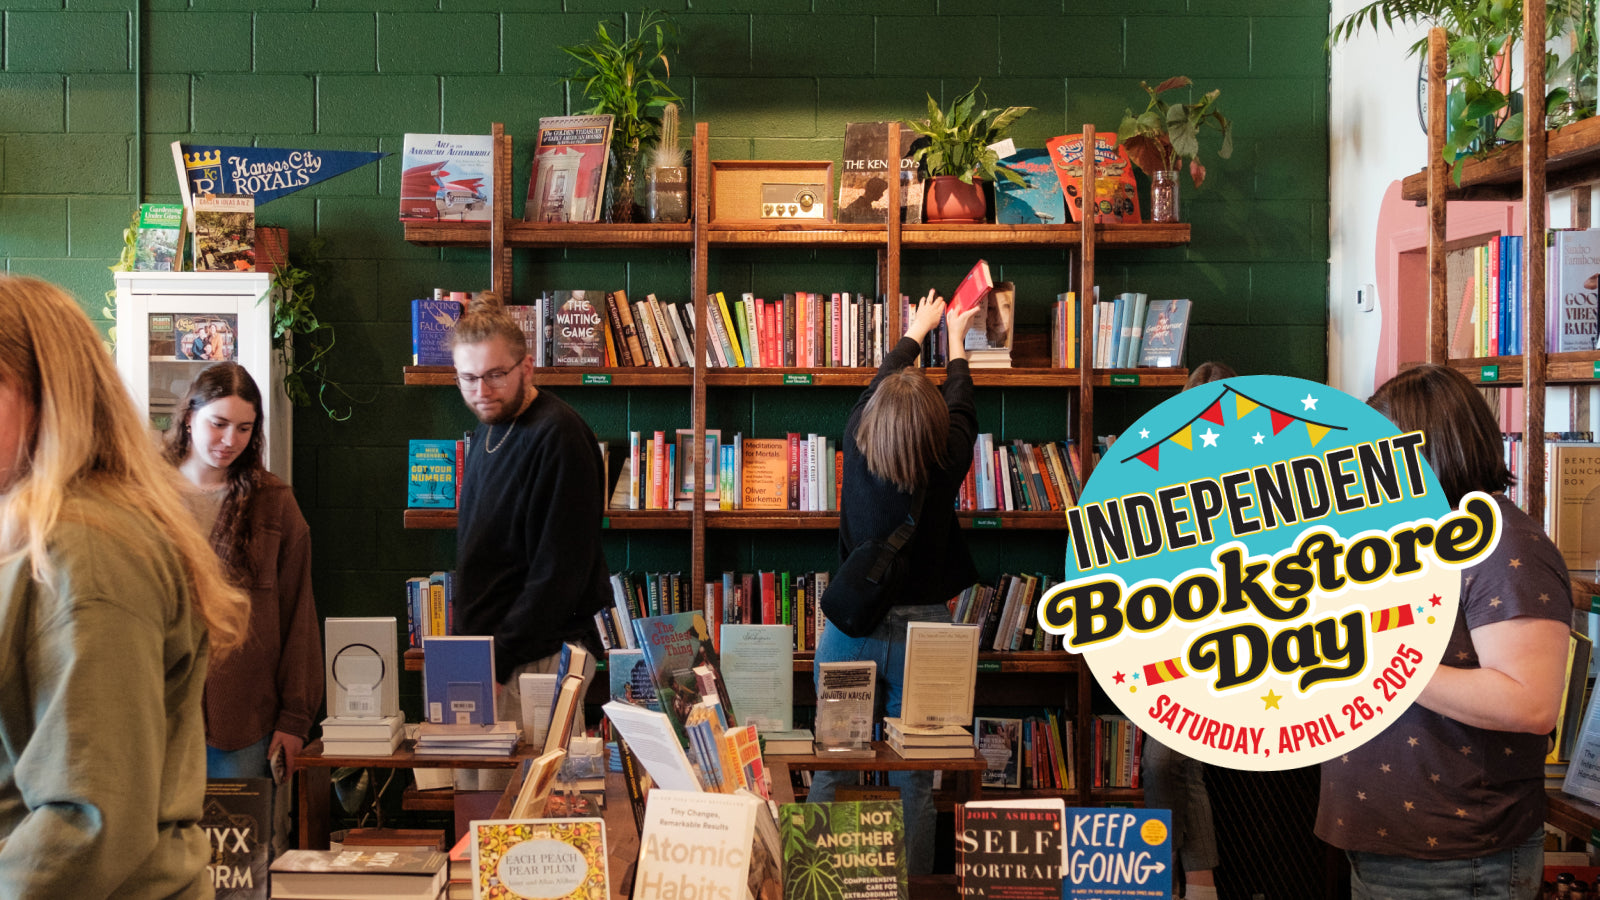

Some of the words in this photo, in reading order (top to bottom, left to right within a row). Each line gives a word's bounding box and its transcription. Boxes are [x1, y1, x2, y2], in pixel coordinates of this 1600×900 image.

[228, 156, 290, 179] Kansas
[288, 151, 322, 173] City
[845, 160, 865, 170] THE
[868, 158, 921, 168] KENDYS
[204, 169, 218, 180] KC
[233, 168, 310, 194] ROYALS
[149, 206, 182, 214] Gardening
[568, 300, 590, 311] THE
[1565, 293, 1598, 306] GOO
[420, 302, 459, 311] HUNTING
[556, 314, 602, 325] WAITING
[420, 322, 454, 332] FALCO
[562, 327, 594, 338] GAME
[411, 465, 428, 473] GOT
[430, 465, 452, 473] YOUR
[411, 474, 452, 482] NUMBER
[745, 486, 766, 494] Oliver
[654, 622, 674, 634] The
[652, 630, 692, 646] Greatest
[664, 644, 694, 656] Thing
[820, 690, 847, 700] JUJUTSU
[848, 691, 872, 700] KAISEN
[1585, 750, 1596, 760] The
[670, 808, 686, 817] Tiny
[687, 808, 721, 820] Changes,
[860, 811, 892, 826] NOT
[967, 812, 998, 820] JOHN
[1004, 811, 1058, 822] ASHBERY
[660, 818, 701, 828] Remarkable
[702, 822, 729, 831] Results
[1071, 813, 1136, 848] KEEP
[816, 831, 894, 848] ANOTHER
[645, 833, 744, 869] Atomic
[506, 854, 537, 865] EACH
[540, 852, 578, 864] PEACH
[832, 852, 896, 868] JUNGLE
[509, 866, 540, 876] PEAR
[543, 864, 576, 875] PLUM
[962, 863, 1062, 880] PORTRAIT
[1070, 850, 1152, 885] GOING
[640, 870, 732, 900] Habits
[843, 876, 898, 886] COMPREHENSIVE
[844, 890, 898, 899] EXTRAORDINARY
[976, 888, 984, 896] A
